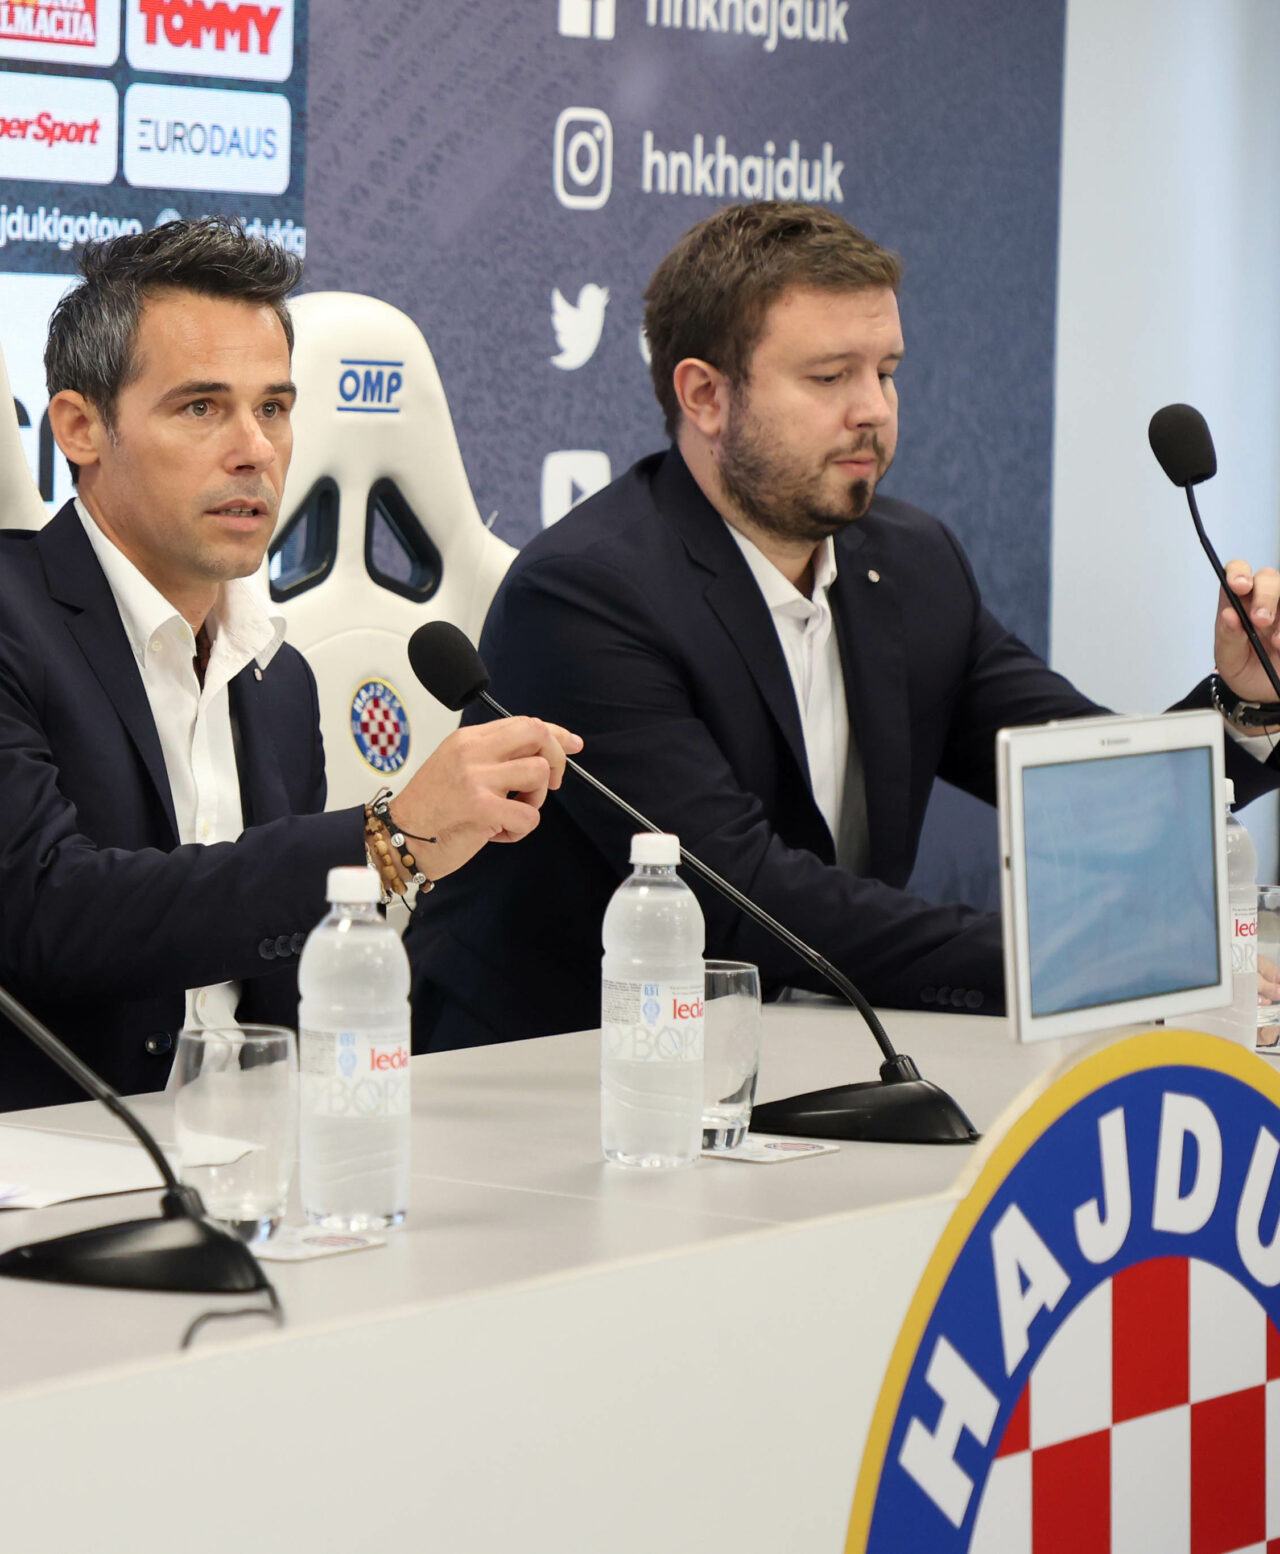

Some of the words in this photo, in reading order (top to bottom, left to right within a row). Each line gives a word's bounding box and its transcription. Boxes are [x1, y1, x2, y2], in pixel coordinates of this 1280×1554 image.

[139, 0, 282, 55] TOMMY
[138, 118, 278, 159] EURODAUS
[642, 130, 845, 202] hnkhajduk
[339, 369, 402, 403] OMP
